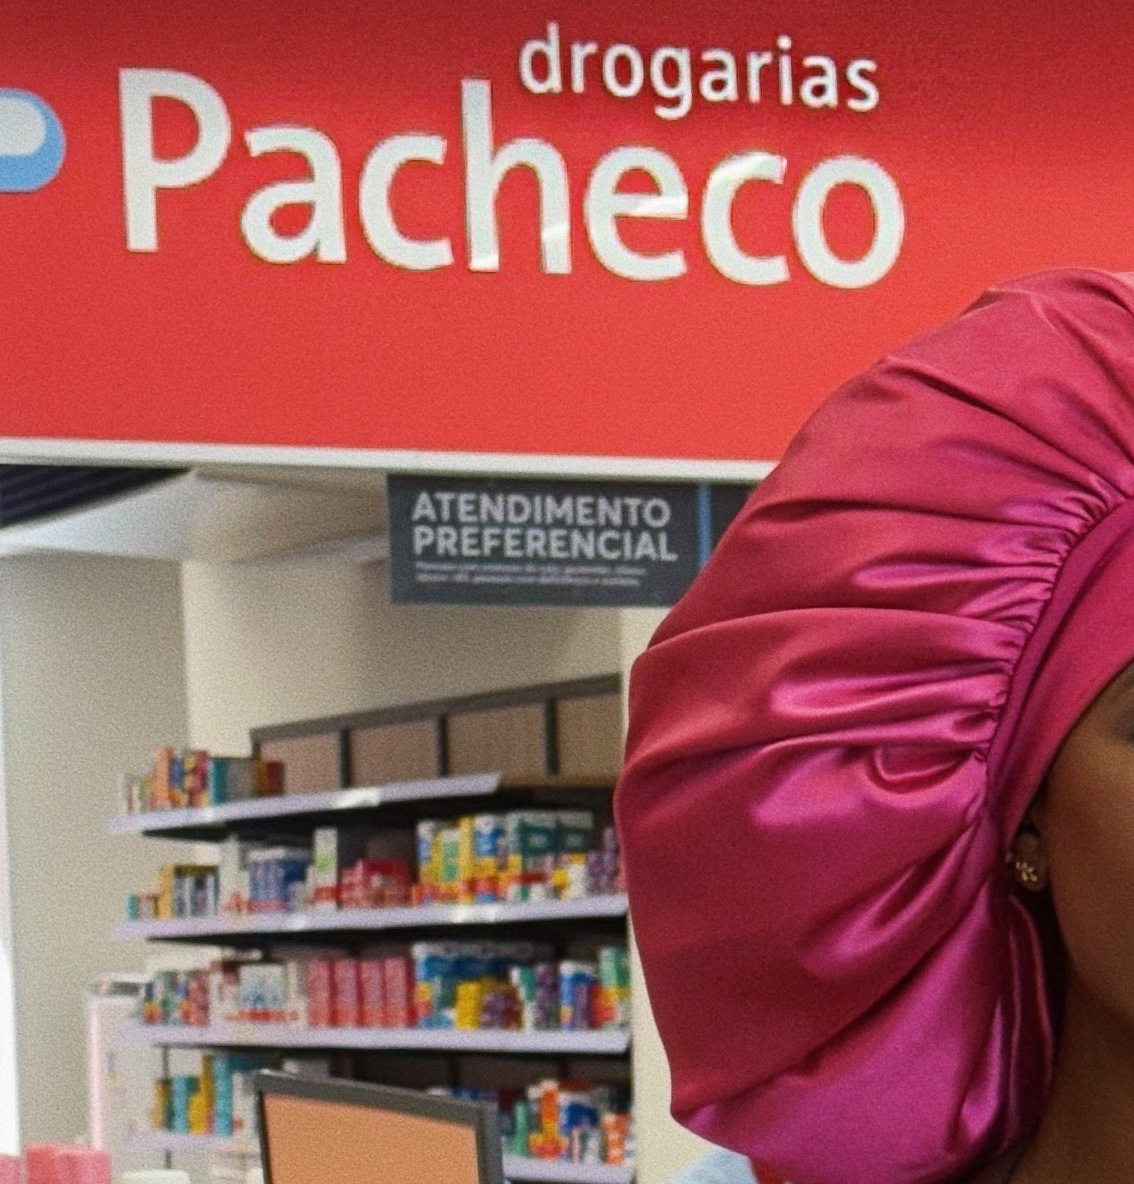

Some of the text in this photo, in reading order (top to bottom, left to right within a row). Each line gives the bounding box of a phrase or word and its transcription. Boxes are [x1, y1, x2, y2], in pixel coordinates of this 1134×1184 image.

[518, 21, 881, 120] drogarias
[118, 66, 905, 289] Pacheco
[411, 491, 671, 528] ATENDIMENTO
[412, 524, 680, 563] PREFERENCIAL
